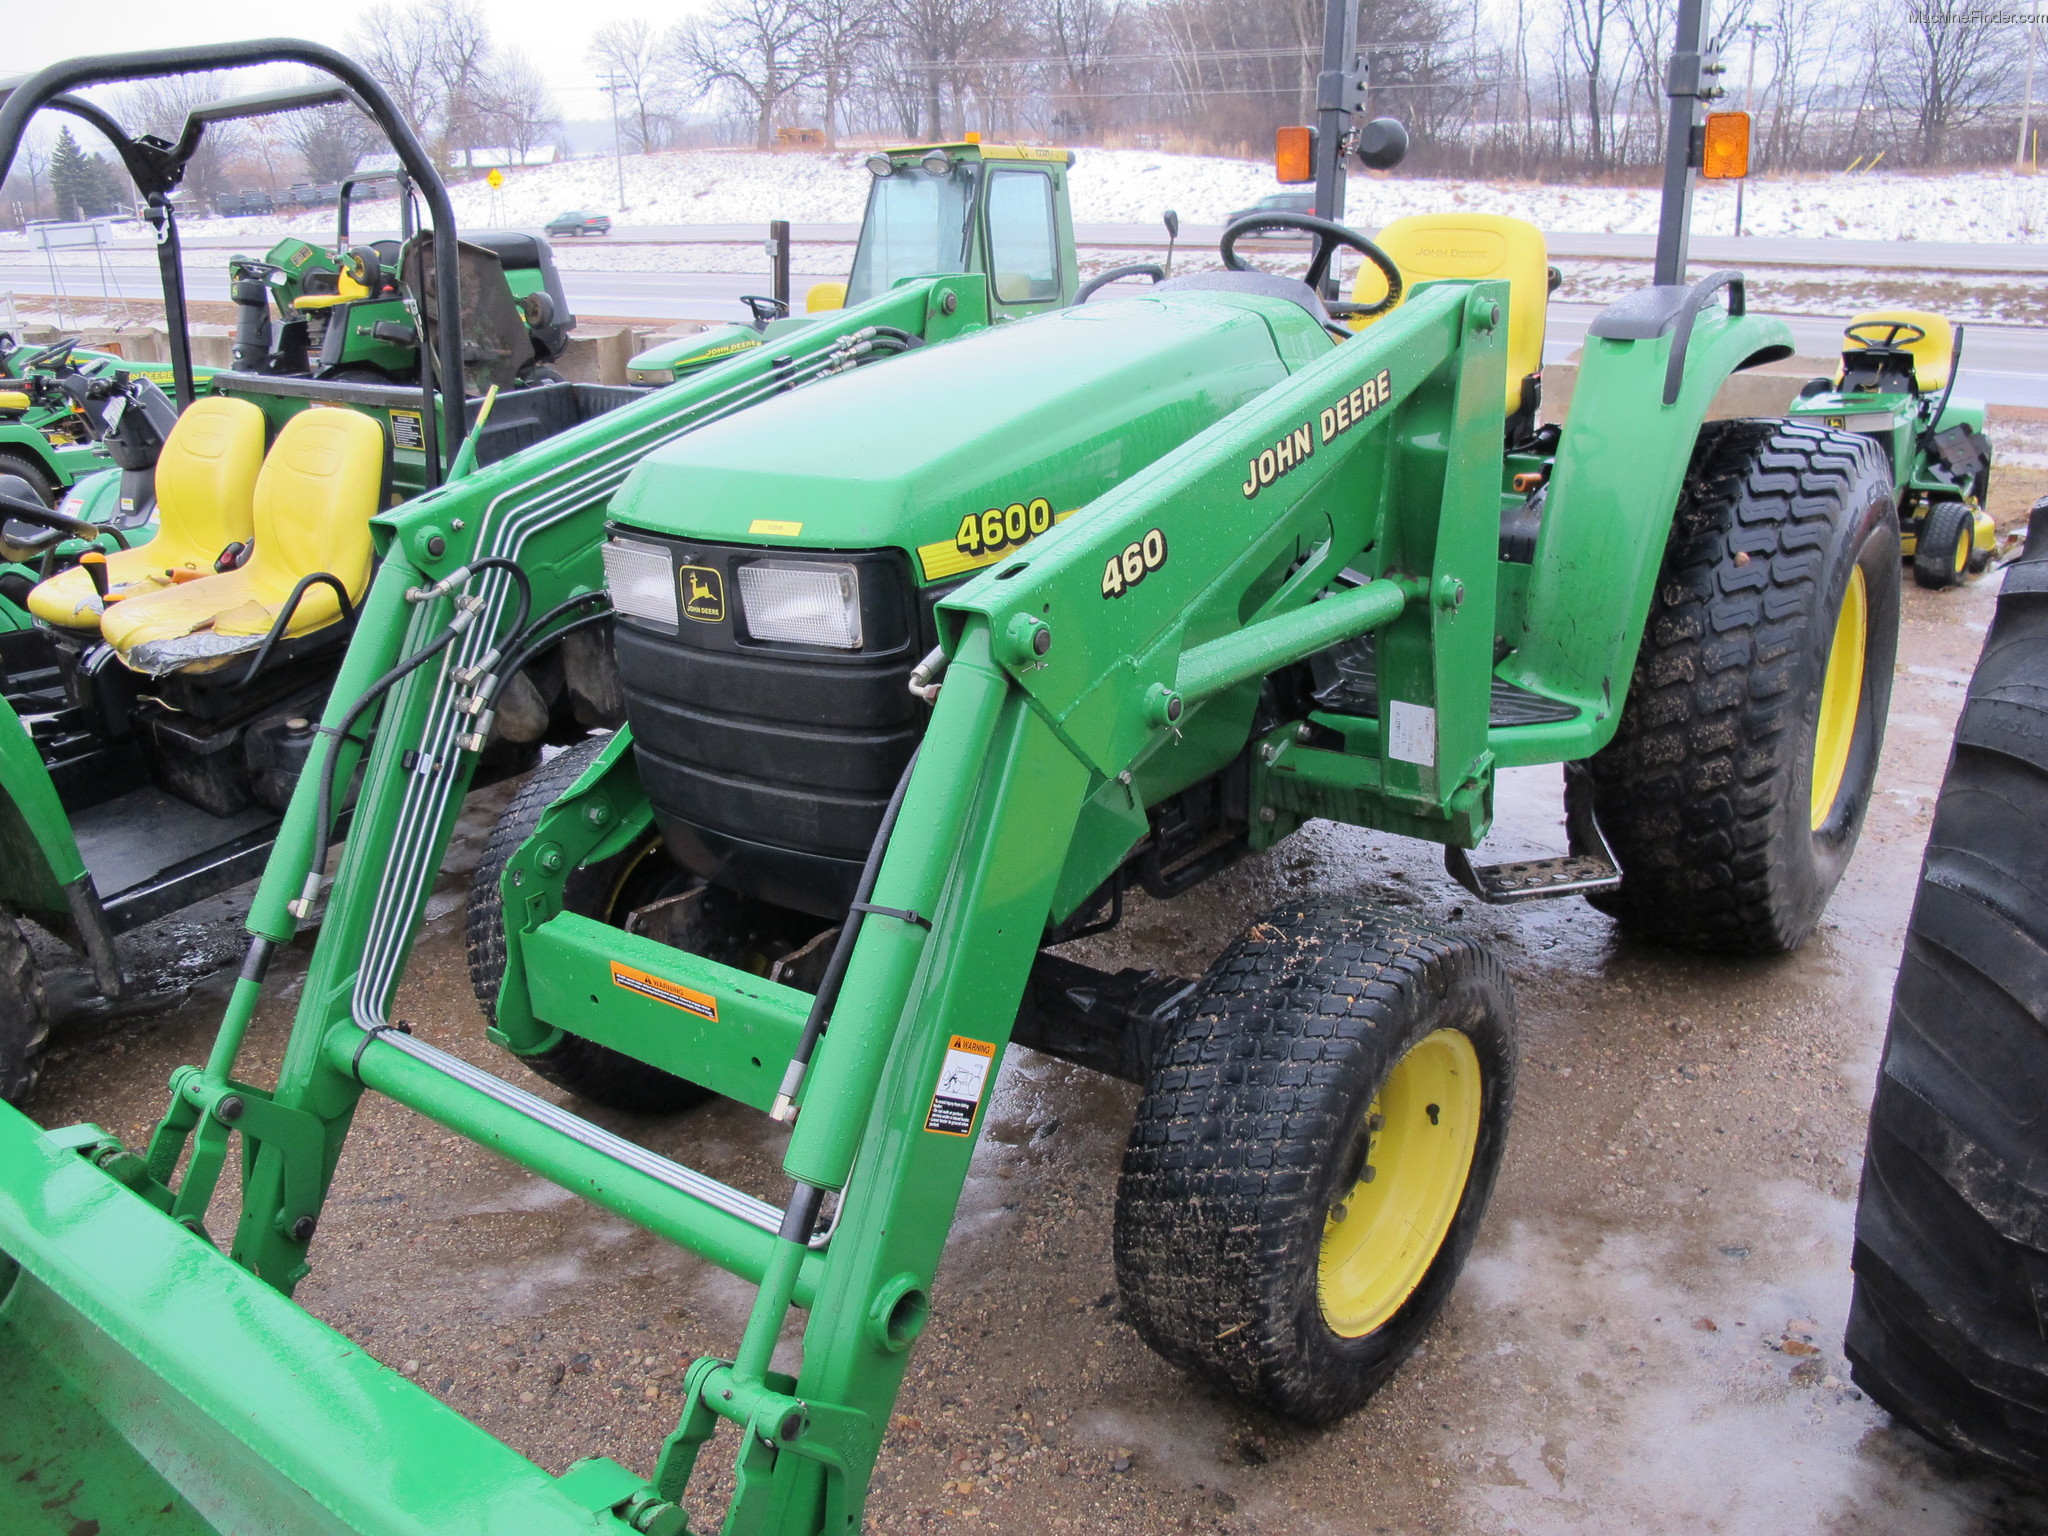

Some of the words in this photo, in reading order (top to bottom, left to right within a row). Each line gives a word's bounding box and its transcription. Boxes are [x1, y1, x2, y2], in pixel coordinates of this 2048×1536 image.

[706, 346, 729, 356] JOHN
[731, 340, 756, 350] DEERE
[140, 371, 174, 379] DEERE
[1242, 421, 1315, 500] JOHN
[1320, 368, 1392, 446] DEERE
[956, 498, 1053, 554] 4600
[1102, 528, 1167, 600] 460
[687, 605, 700, 613] JOHN
[701, 607, 720, 616] DEERE
[652, 980, 684, 996] WARNING
[962, 1040, 990, 1054] WARNING
